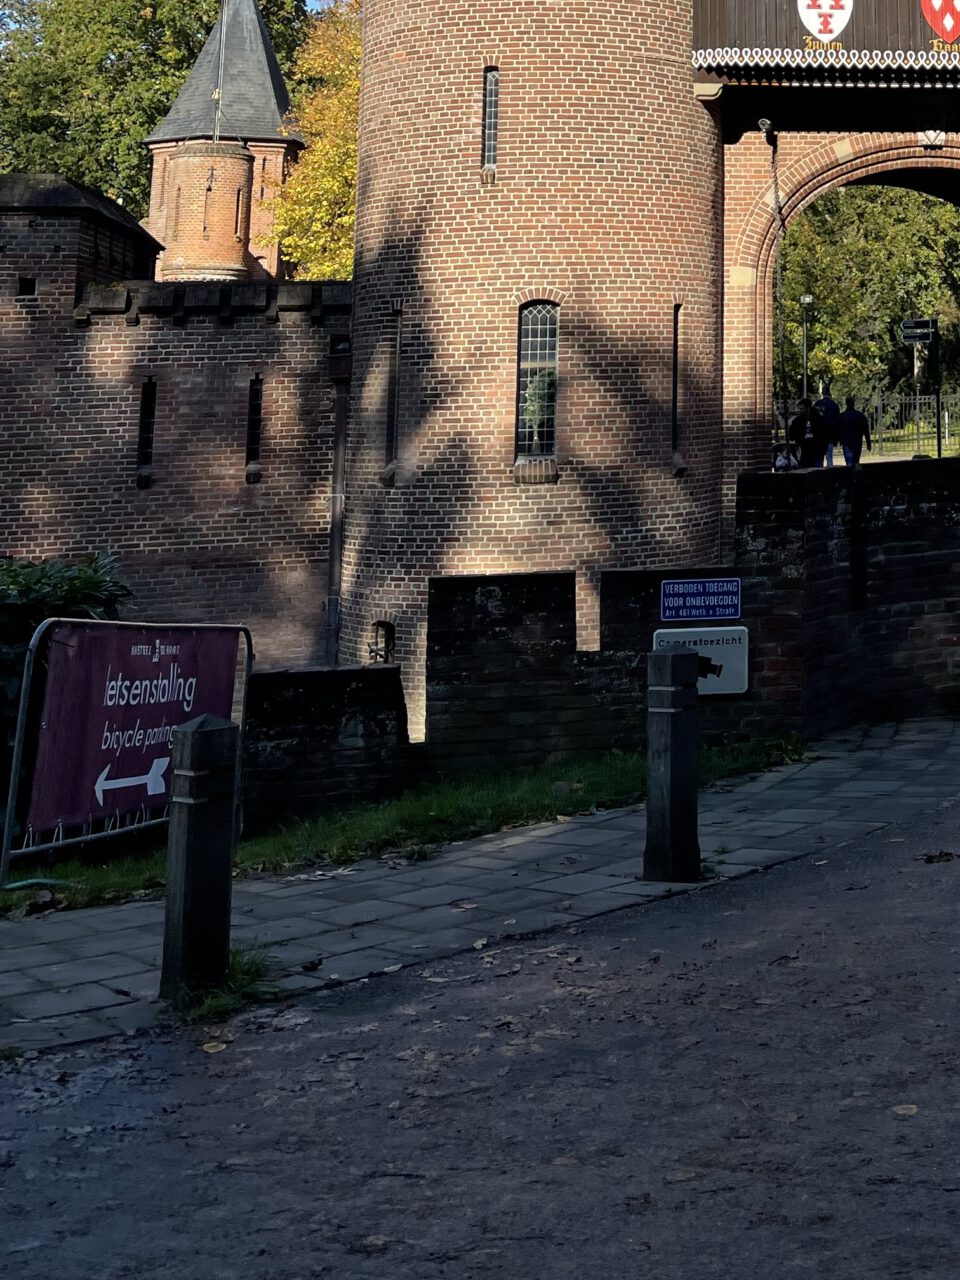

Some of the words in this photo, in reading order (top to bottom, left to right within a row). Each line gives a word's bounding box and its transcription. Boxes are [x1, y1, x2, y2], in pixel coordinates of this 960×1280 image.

[664, 583, 703, 594] VERBODEN
[705, 581, 738, 592] TOEGANG
[663, 596, 684, 607] VOOR
[685, 595, 738, 607] ONBEVOEGDEN
[101, 718, 144, 757] bicycle
